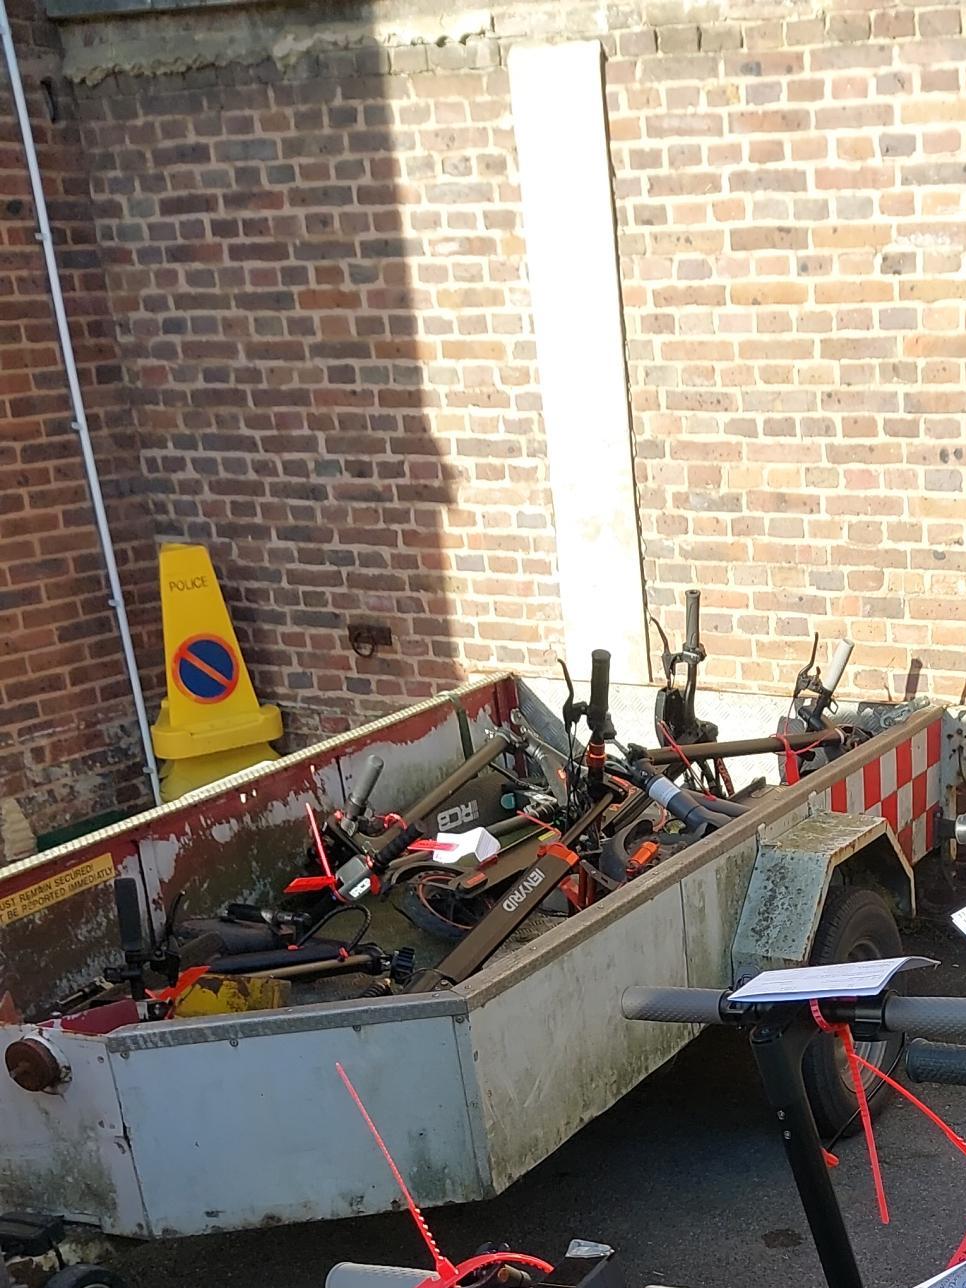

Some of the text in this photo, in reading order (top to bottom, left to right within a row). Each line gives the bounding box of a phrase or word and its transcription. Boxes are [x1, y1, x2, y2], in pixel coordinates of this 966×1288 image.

[168, 576, 209, 592] POLICE
[19, 881, 52, 903] REMAIN
[7, 907, 20, 919] BE
[22, 888, 66, 912] REPORTED
